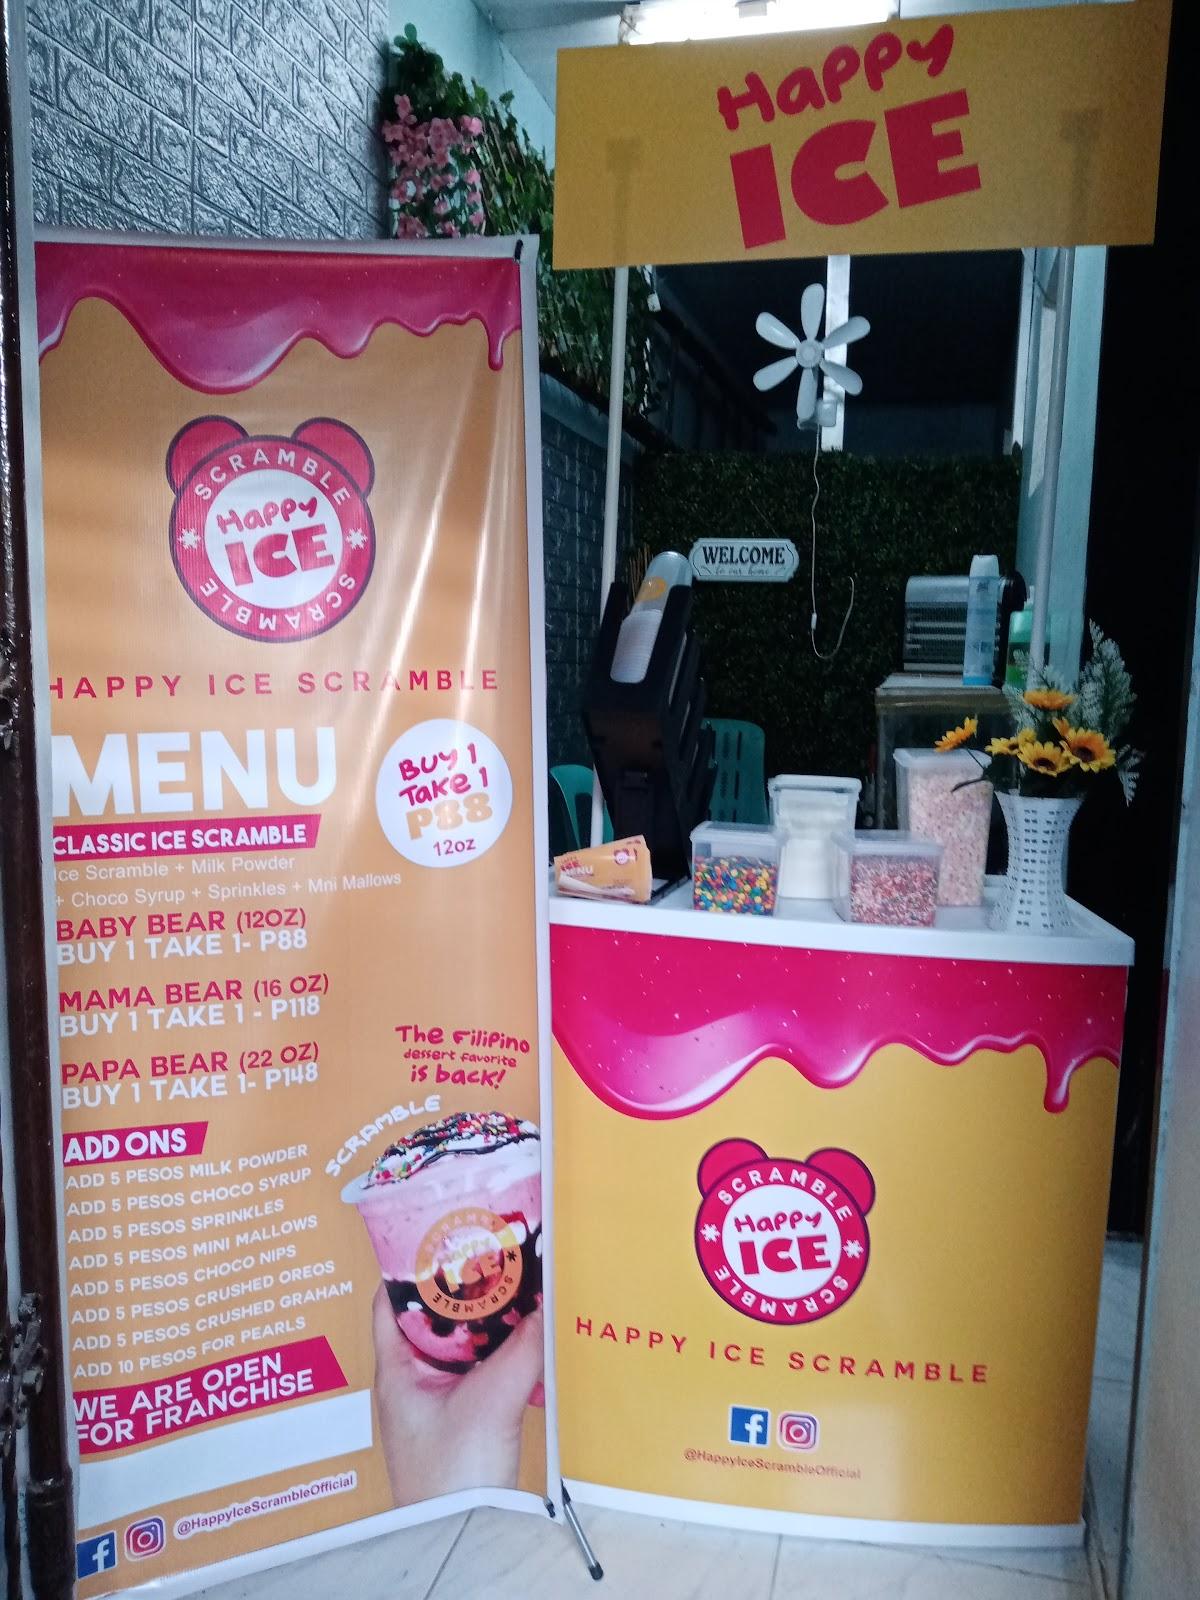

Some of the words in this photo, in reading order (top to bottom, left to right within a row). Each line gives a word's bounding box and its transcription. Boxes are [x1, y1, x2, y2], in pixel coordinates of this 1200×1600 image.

[717, 24, 955, 130] Happy
[730, 88, 981, 249] ICE
[194, 448, 351, 505] SCRAMBLE
[216, 496, 318, 534] Happy
[224, 524, 335, 586] ICE
[702, 546, 785, 564] WELCOME
[200, 573, 355, 631] SCRAMBLE
[208, 673, 272, 695] ICE
[298, 670, 498, 694] SCRAMBLE
[51, 727, 336, 817] MENU
[399, 748, 458, 781] BUY
[467, 743, 477, 764] 1
[399, 772, 471, 806] Take
[479, 767, 489, 787] 1
[405, 792, 493, 840] P88
[53, 832, 145, 855] CLASSIC
[152, 830, 186, 850] ICE
[192, 824, 306, 849] SCRAMBLE
[433, 838, 476, 856] 12oz
[71, 890, 128, 908] Choco
[135, 888, 185, 907] Syrup
[208, 882, 286, 901] Sprinkles
[343, 872, 401, 891] Mallows
[86, 862, 168, 880] Scramble
[192, 858, 225, 874] Milk
[232, 855, 295, 871] Powder
[56, 915, 136, 941] BABY
[148, 911, 226, 935] BEAR
[236, 907, 306, 934] (12OZ)
[57, 940, 116, 966] BUY
[126, 940, 135, 961] 1
[144, 933, 223, 959] TAKE
[259, 928, 307, 951] P88
[59, 986, 155, 1013] MAMA
[165, 979, 242, 1005] BEAR
[253, 979, 282, 1003] (16
[290, 973, 329, 995] OZ)
[59, 1012, 118, 1037] BUY
[128, 1011, 137, 1032] 1
[146, 1004, 225, 1030] TAKE
[234, 1003, 243, 1024] 1
[271, 995, 320, 1020] P118
[395, 1024, 444, 1044] The
[453, 1029, 530, 1053] Filipino
[61, 1058, 140, 1085] PAPA
[150, 1051, 228, 1077] BEAR
[239, 1049, 272, 1074] (22
[280, 1041, 319, 1064] OZ)
[404, 1049, 456, 1060] dessert
[460, 1053, 517, 1068] favorite
[411, 1064, 428, 1082] is
[435, 1064, 506, 1089] back!
[62, 1084, 121, 1109] BUY
[131, 1082, 140, 1103] 1
[150, 1075, 228, 1101] TAKE
[265, 1062, 318, 1090] P148
[64, 1134, 120, 1163] ADD
[125, 1127, 187, 1156] ONS
[325, 1094, 441, 1177] SCRAMBLE
[65, 1173, 105, 1189] ADD
[111, 1172, 120, 1185] 5
[126, 1166, 184, 1184] PESOS
[189, 1160, 232, 1178] MILK
[238, 1143, 308, 1171] POWDER
[66, 1200, 106, 1216] ADD
[112, 1199, 121, 1212] 5
[127, 1192, 185, 1211] PESOS
[190, 1182, 254, 1205] CHOCO
[259, 1167, 312, 1192] SYRUP
[717, 1167, 852, 1221] SCRAMBLE
[67, 1227, 107, 1243] ADD
[113, 1225, 122, 1239] 5
[128, 1219, 186, 1238] PESOS
[191, 1198, 285, 1231] SPRINKLES
[68, 1254, 108, 1270] ADD
[114, 1252, 123, 1266] 5
[129, 1245, 187, 1264] PESOS
[192, 1237, 230, 1257] MINI
[236, 1215, 318, 1247] MALLOWS
[734, 1210, 821, 1233] Happy
[70, 1281, 109, 1297] ADD
[115, 1279, 124, 1293] 5
[130, 1272, 189, 1291] PESOS
[194, 1255, 255, 1282] CHOCO
[259, 1244, 297, 1265] NIPS
[739, 1234, 832, 1275] ICE
[71, 1307, 110, 1324] ADD
[116, 1306, 125, 1320] 5
[131, 1297, 190, 1319] PESOS
[195, 1275, 274, 1307] CRUSHED
[279, 1260, 335, 1284] OREOS
[432, 1275, 513, 1312] SCRAMBLE
[714, 1264, 848, 1317] SCRAMBLE
[72, 1334, 111, 1351] ADD
[117, 1333, 126, 1347] 5
[132, 1322, 191, 1345] PESOS
[196, 1299, 275, 1332] CRUSHED
[279, 1280, 353, 1308] GRAHAM
[73, 1362, 112, 1379] ADD
[119, 1360, 133, 1374] 10
[140, 1346, 197, 1371] PESOS
[202, 1334, 235, 1355] FOR
[241, 1316, 306, 1343] PEARLS
[576, 1316, 687, 1353] HAPPY
[709, 1341, 765, 1366] ICE
[788, 1351, 988, 1383] SCRAMBLE
[73, 1394, 118, 1422] WE
[129, 1377, 193, 1415] ARE
[202, 1352, 282, 1392] OPEN
[146, 1368, 314, 1435] FRANCHISE
[177, 1474, 353, 1536] @HappyIceScrambleOfficial
